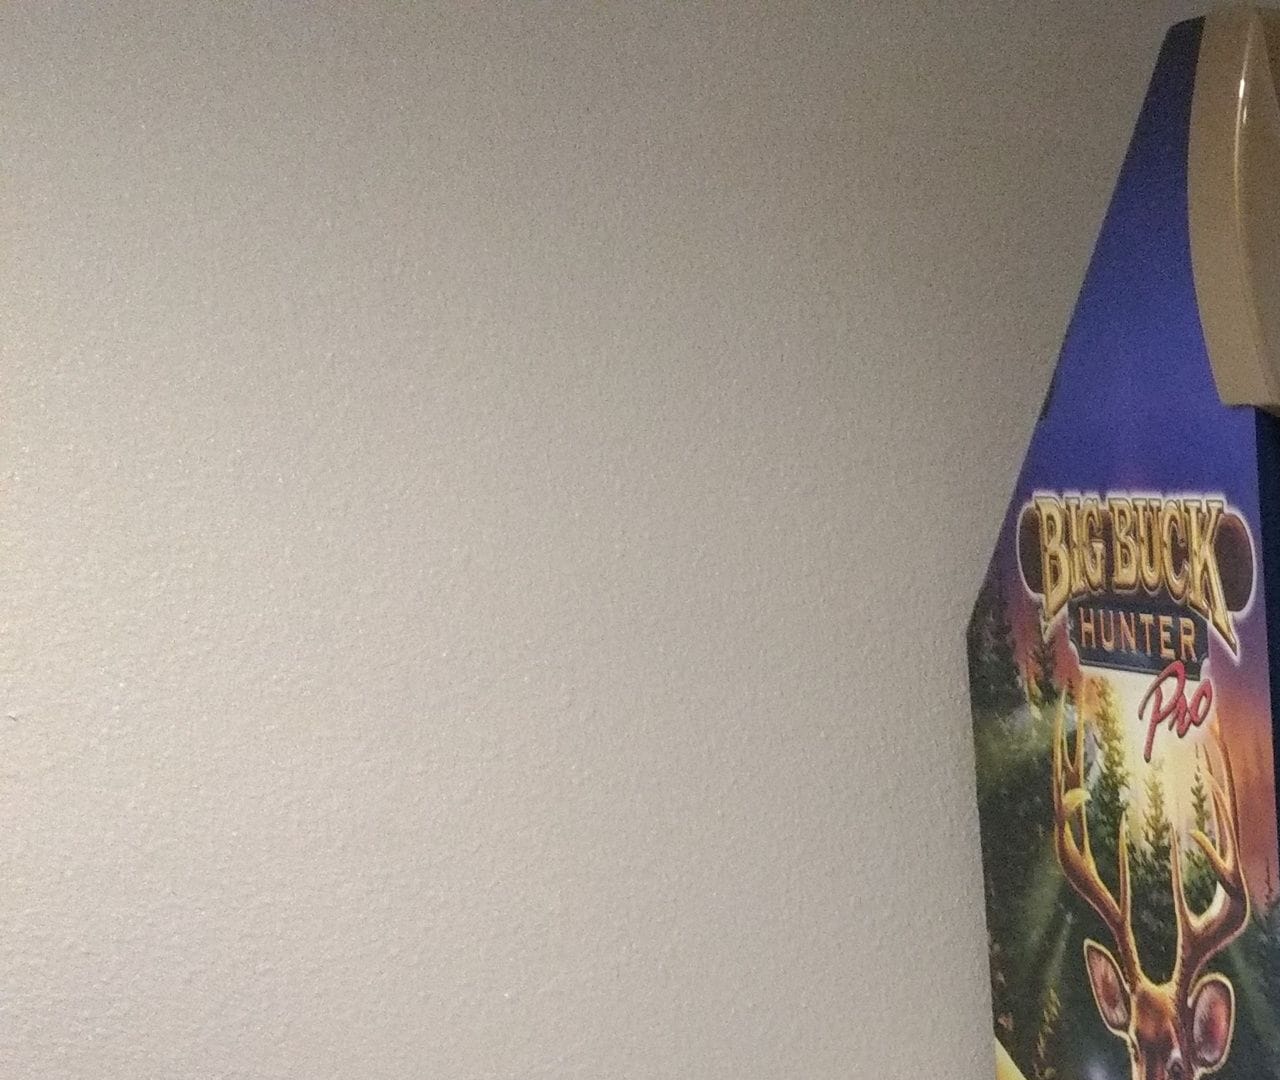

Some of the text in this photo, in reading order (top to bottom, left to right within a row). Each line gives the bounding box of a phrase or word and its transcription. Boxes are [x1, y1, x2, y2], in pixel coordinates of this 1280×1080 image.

[1034, 495, 1238, 658] BIG BUCK
[1079, 606, 1198, 663] HUNTER
[1138, 660, 1213, 764] Pro
